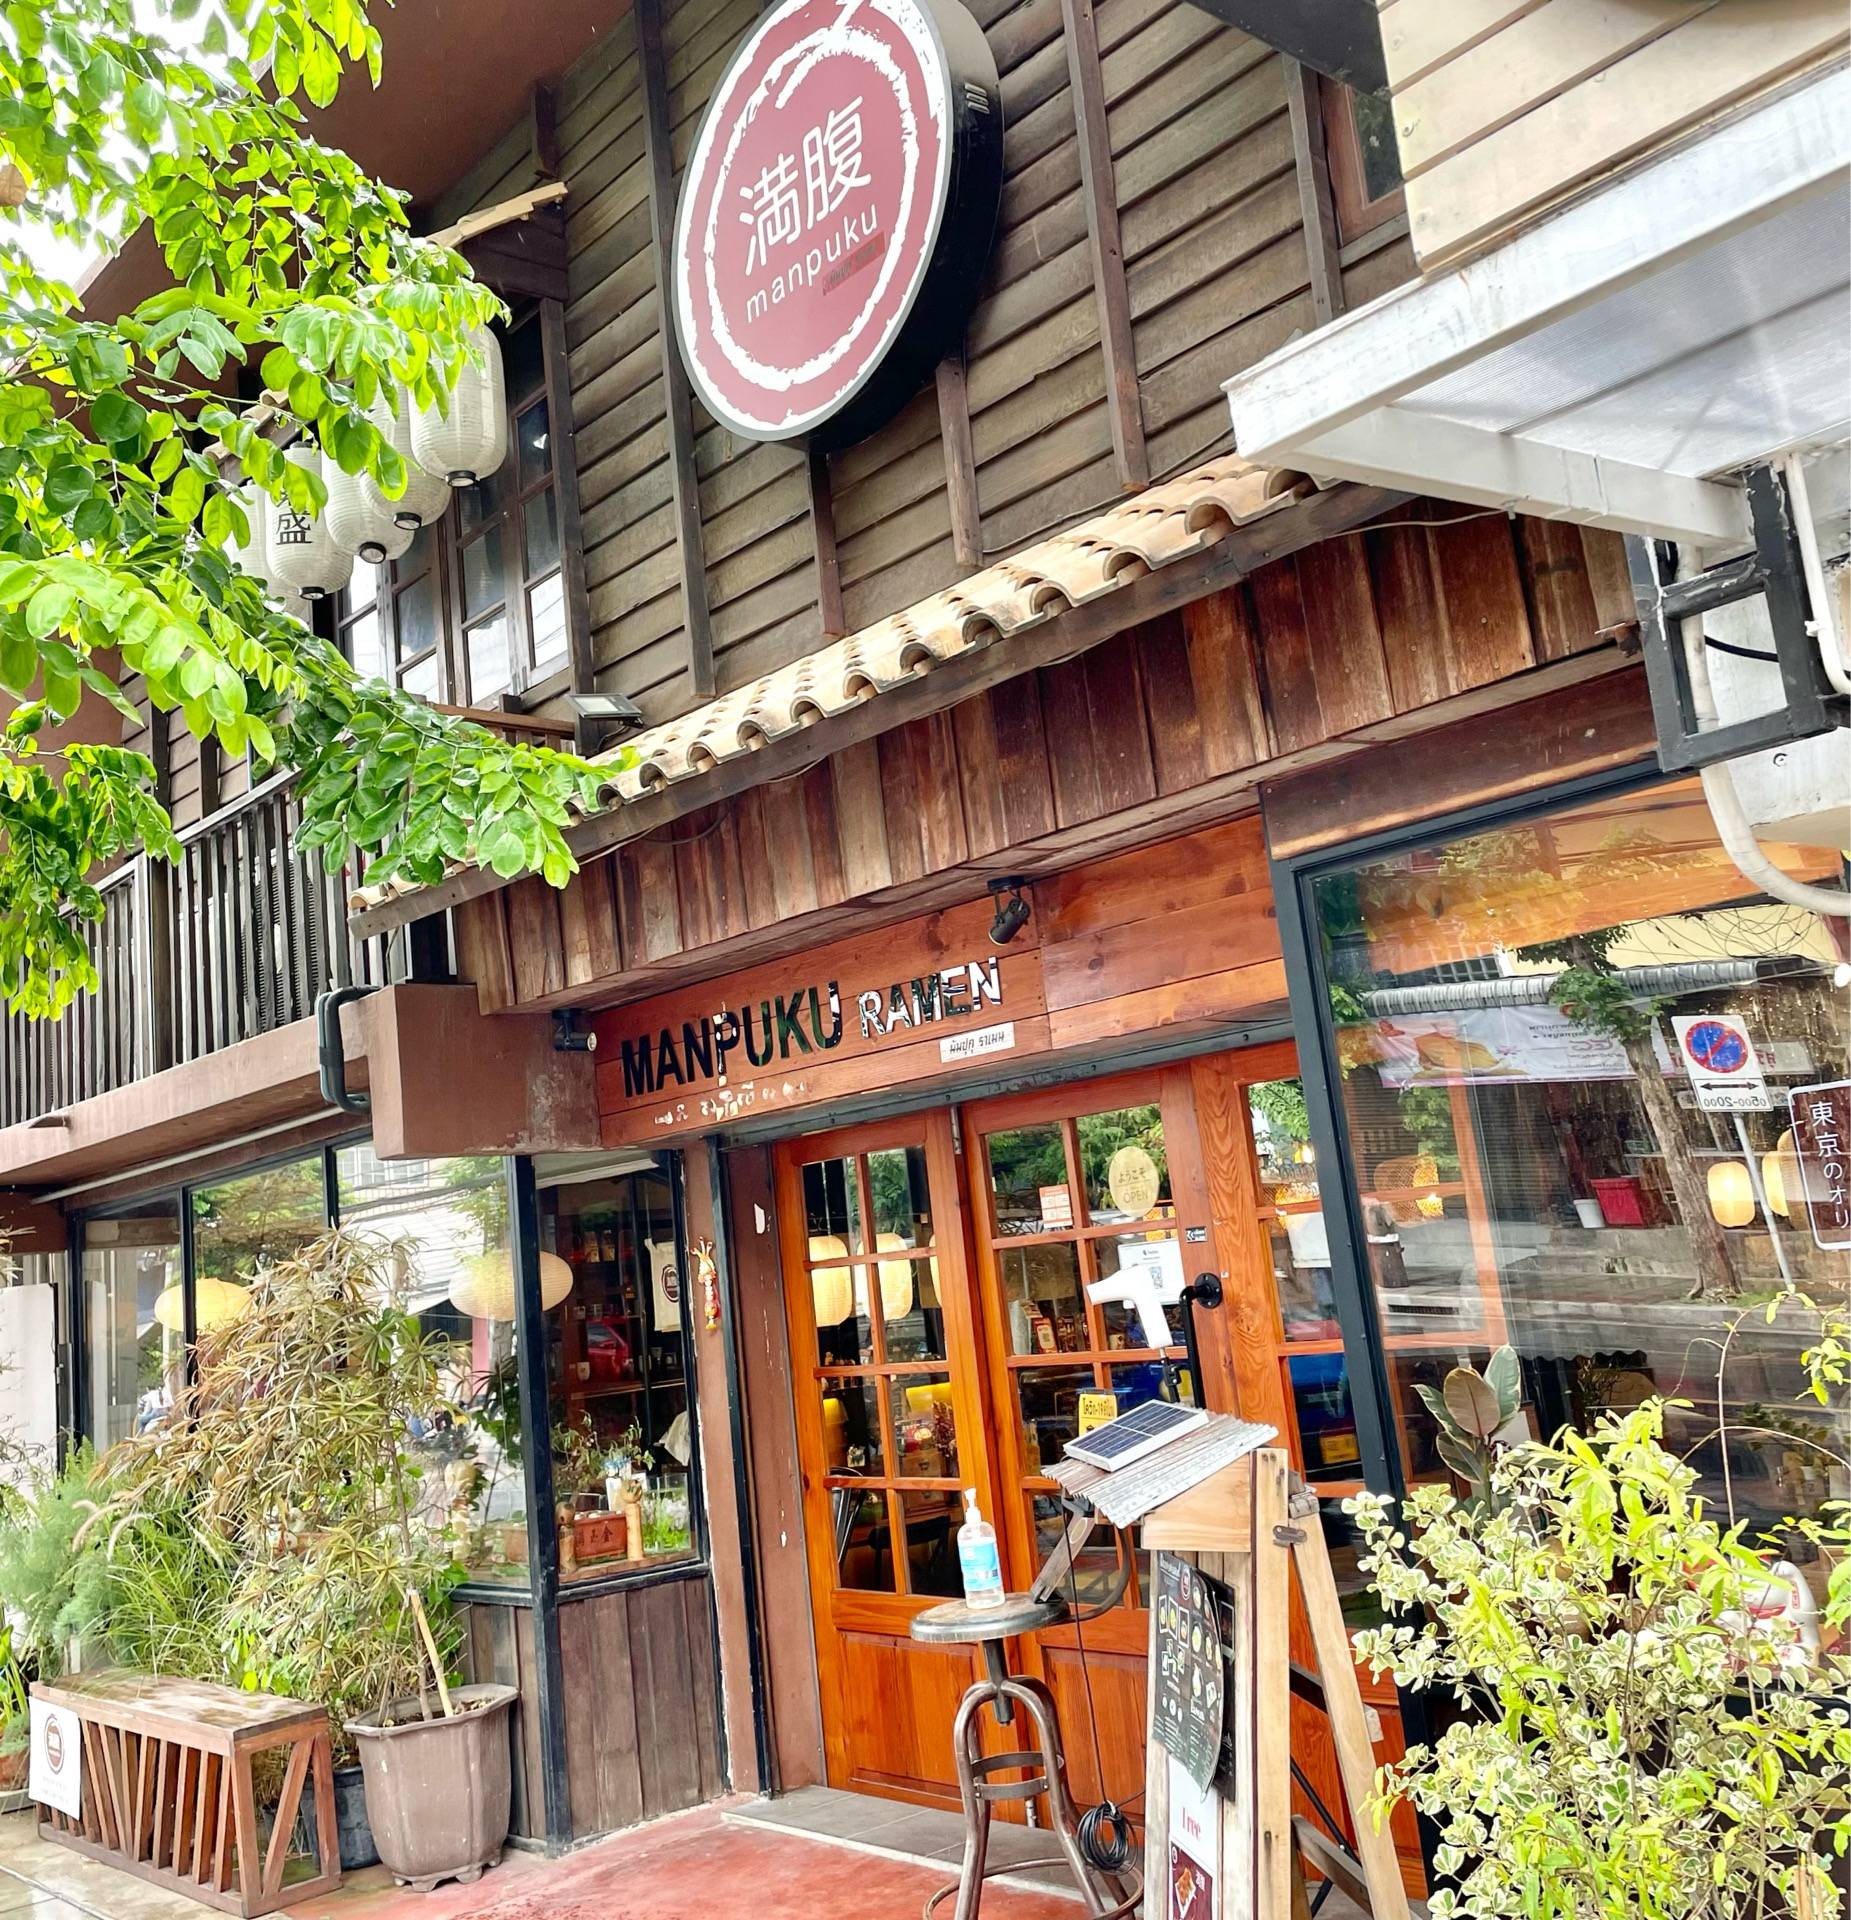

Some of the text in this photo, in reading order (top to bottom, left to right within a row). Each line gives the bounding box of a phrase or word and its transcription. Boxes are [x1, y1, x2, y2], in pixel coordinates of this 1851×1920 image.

[739, 95, 872, 277] 満腹
[746, 203, 878, 323] manpuku
[621, 955, 1002, 1098] MANPUKU RAMEN
[1123, 1190, 1149, 1204] OPEN
[1809, 1101, 1850, 1229] 東京のオリ
